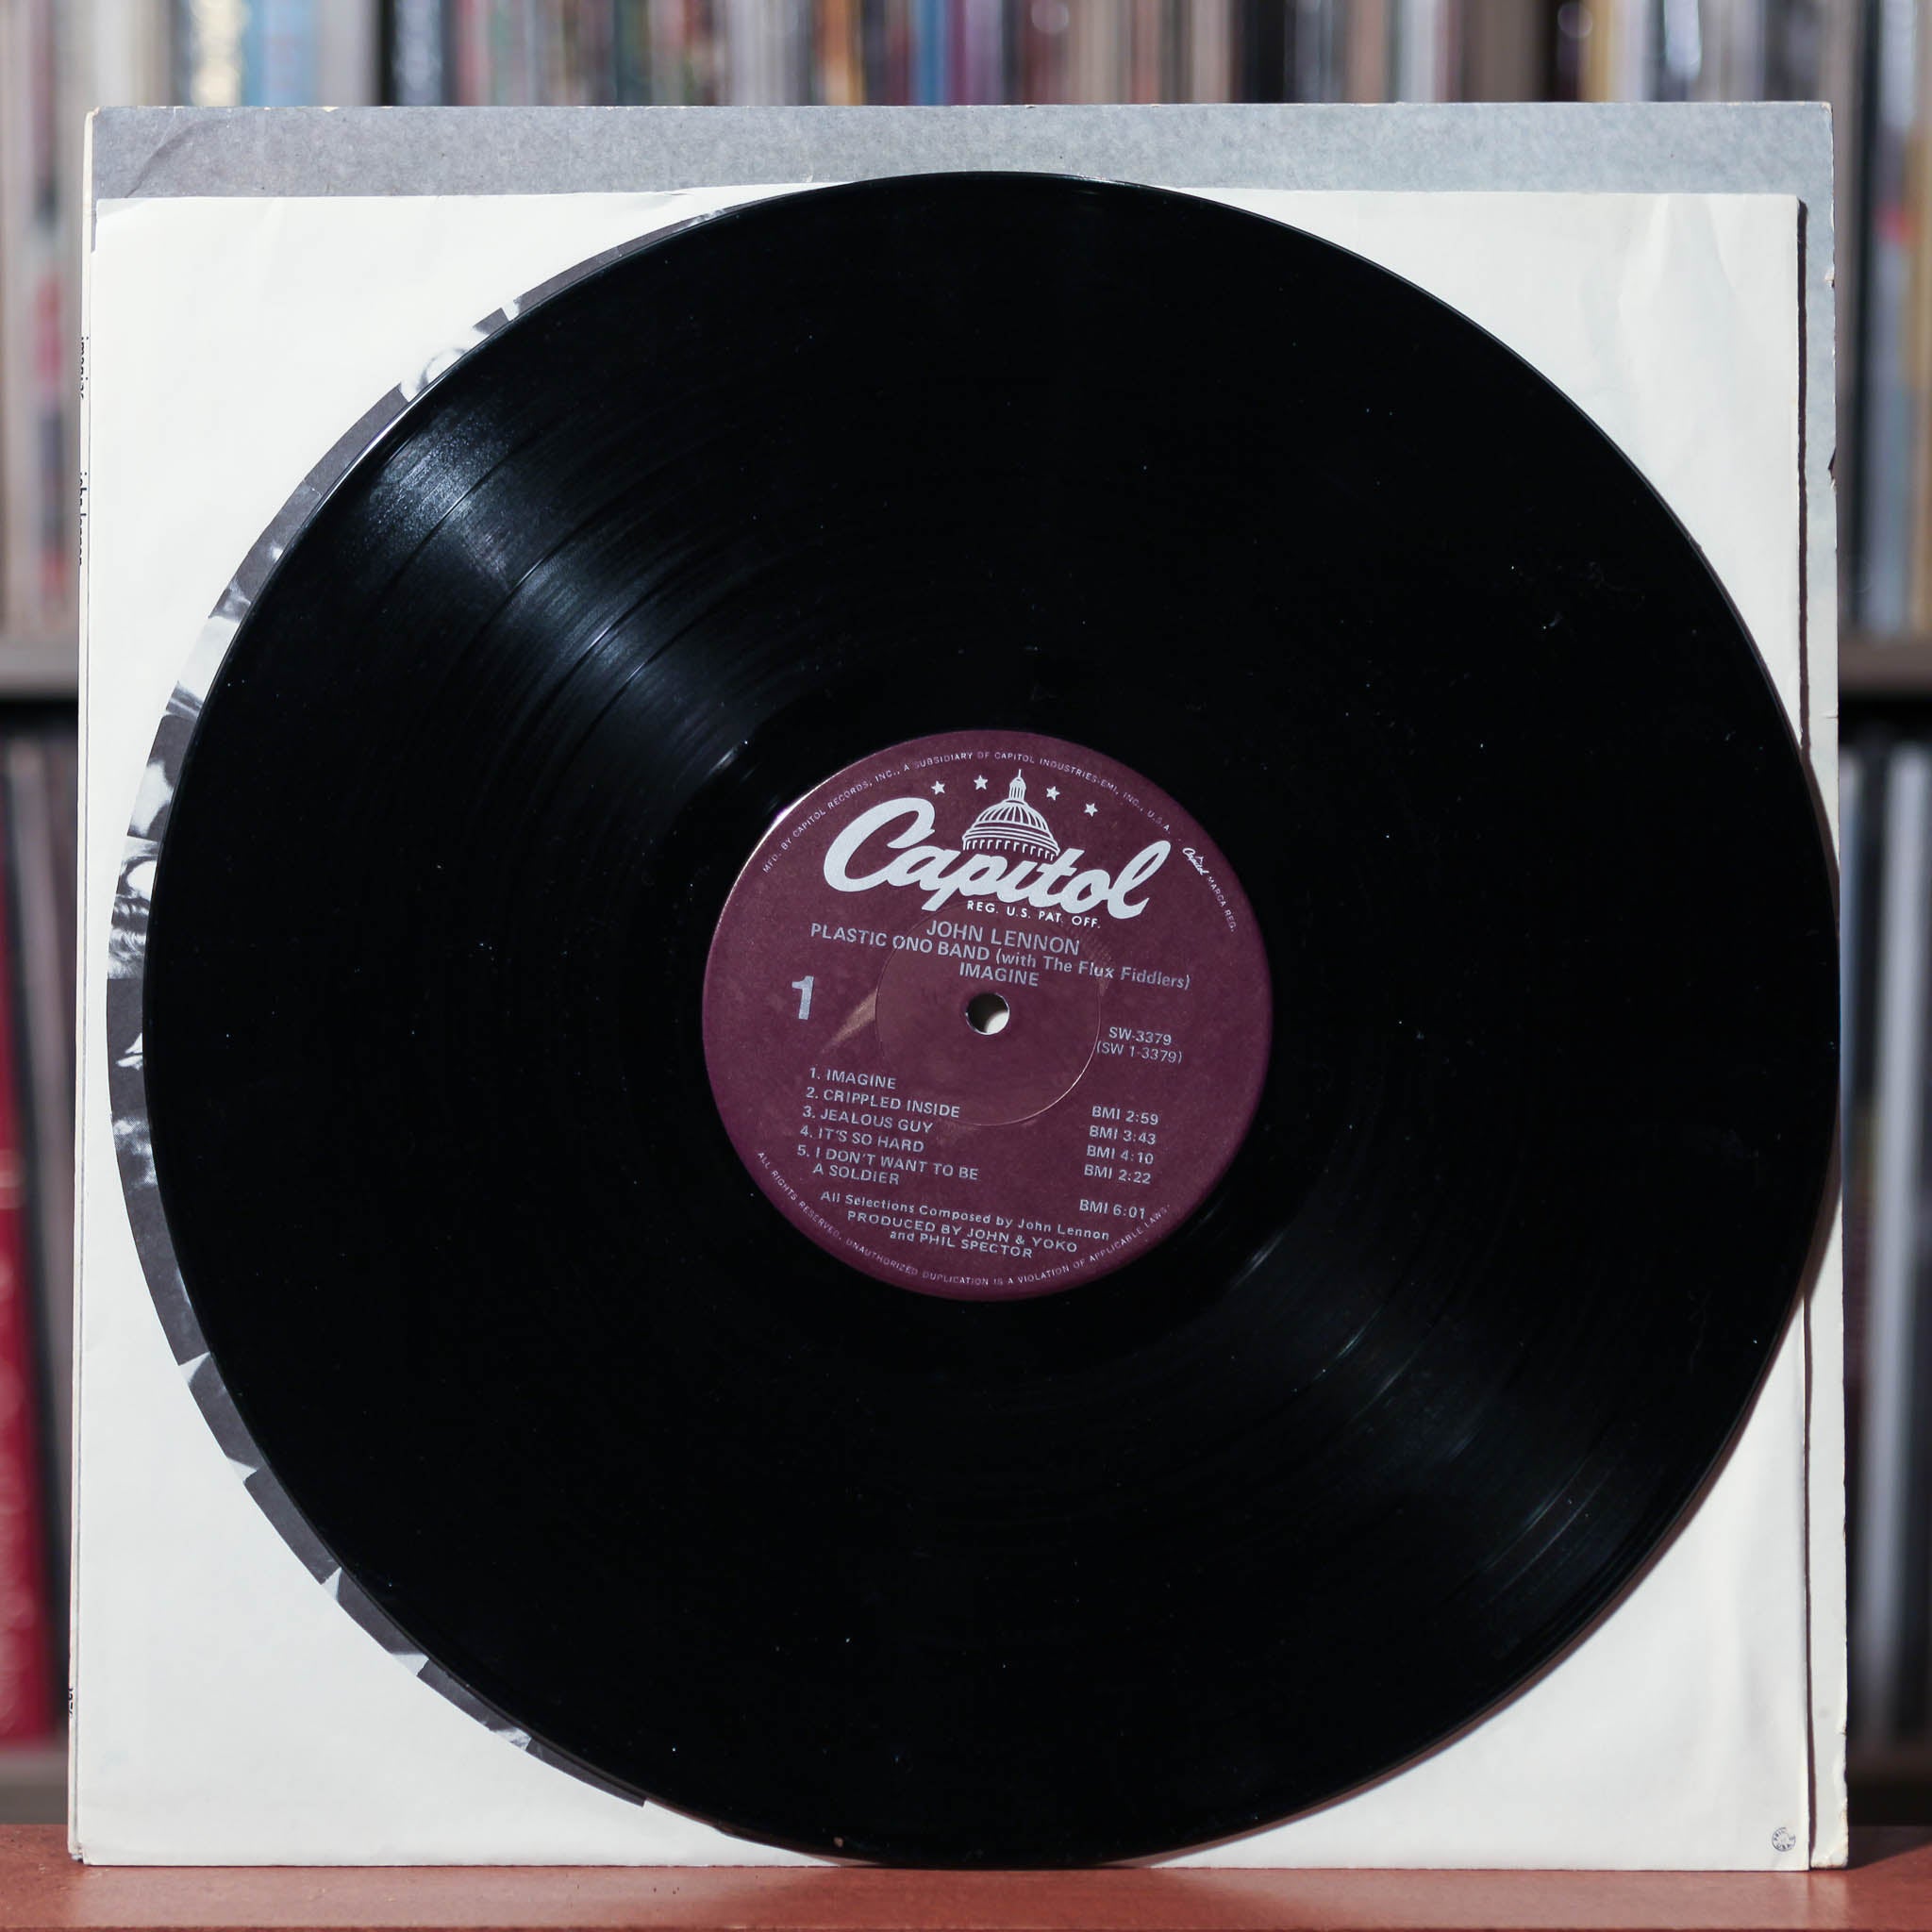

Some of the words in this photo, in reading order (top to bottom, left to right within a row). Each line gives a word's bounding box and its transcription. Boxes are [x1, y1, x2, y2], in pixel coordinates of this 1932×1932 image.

[780, 837, 792, 850] BY
[792, 809, 826, 838] CAPITOL
[913, 752, 973, 769] SUBSIDIARY
[994, 752, 1035, 763] CAPITOL
[824, 797, 1171, 919] Capitol
[1208, 876, 1226, 907] MARCA
[967, 900, 999, 914] REG.
[1007, 906, 1031, 919] U.S.
[1038, 910, 1064, 924] PAT.
[1072, 915, 1101, 929] OFF.
[926, 920, 984, 942] JOHN
[991, 927, 1080, 956] LENNON
[810, 923, 887, 947] PLASTIC
[892, 934, 933, 954] ONO
[937, 941, 991, 961] BAND
[995, 948, 1036, 968] (with
[1042, 956, 1073, 974] The
[1078, 960, 1114, 979] Flux
[1121, 968, 1191, 991] Fiddlers)
[959, 961, 1040, 987] IMAGINE
[791, 975, 814, 1021] 1
[809, 1067, 821, 1080] 1.
[826, 1069, 896, 1090] IMAGINE
[806, 1086, 819, 1099] 2.
[824, 1089, 901, 1109] CRIPPLED
[907, 1099, 960, 1118] INSIDE
[1091, 1106, 1121, 1121] BMI
[1125, 1110, 1159, 1125] 2:59
[803, 1106, 816, 1119] 3.
[820, 1108, 892, 1129] JEALOUS
[898, 1119, 933, 1133] GUY
[800, 1125, 813, 1140] 4.
[818, 1127, 848, 1142] IT'S
[852, 1132, 873, 1146] SO
[877, 1136, 924, 1153] HARD
[1089, 1124, 1118, 1141] BMI
[1123, 1130, 1157, 1145] 3:43
[797, 1144, 810, 1158] 5.
[815, 1146, 821, 1158] I
[825, 1148, 875, 1167] DON'T
[880, 1156, 927, 1174] WANT
[933, 1161, 953, 1177] TO
[958, 1167, 979, 1180] BE
[1087, 1144, 1116, 1159] BMI
[1120, 1150, 1154, 1165] 4:10
[812, 1162, 824, 1175] A
[829, 1164, 900, 1185] SOLDIER
[1084, 1164, 1113, 1179] BMI
[1118, 1170, 1152, 1185] 2:22
[758, 1152, 771, 1169] ALL
[771, 1170, 798, 1201] RIGHTS
[845, 1239, 918, 1275] UNAUTHORIZED
[923, 1271, 989, 1286] DUPLICATION
[1017, 1265, 1070, 1284] VIOLATION
[1073, 1258, 1086, 1269] OF
[1090, 1226, 1142, 1262] APPLICABLE
[820, 1191, 841, 1203] All
[845, 1193, 915, 1214] Selections
[919, 1205, 991, 1224] Composed
[995, 1216, 1013, 1228] by
[1018, 1217, 1052, 1233] John
[1058, 1224, 1109, 1241] Lennon
[1079, 1199, 1108, 1214] BMI
[1112, 1204, 1146, 1220] 6:01
[847, 1210, 936, 1233] PRODUCED
[941, 1224, 962, 1236] BY
[967, 1227, 1009, 1243] JOHN
[1015, 1235, 1025, 1245] &
[1031, 1237, 1077, 1253] YOKO
[890, 1230, 915, 1242] and
[920, 1234, 955, 1248] PHIL
[960, 1239, 1033, 1258] SPECTOR
